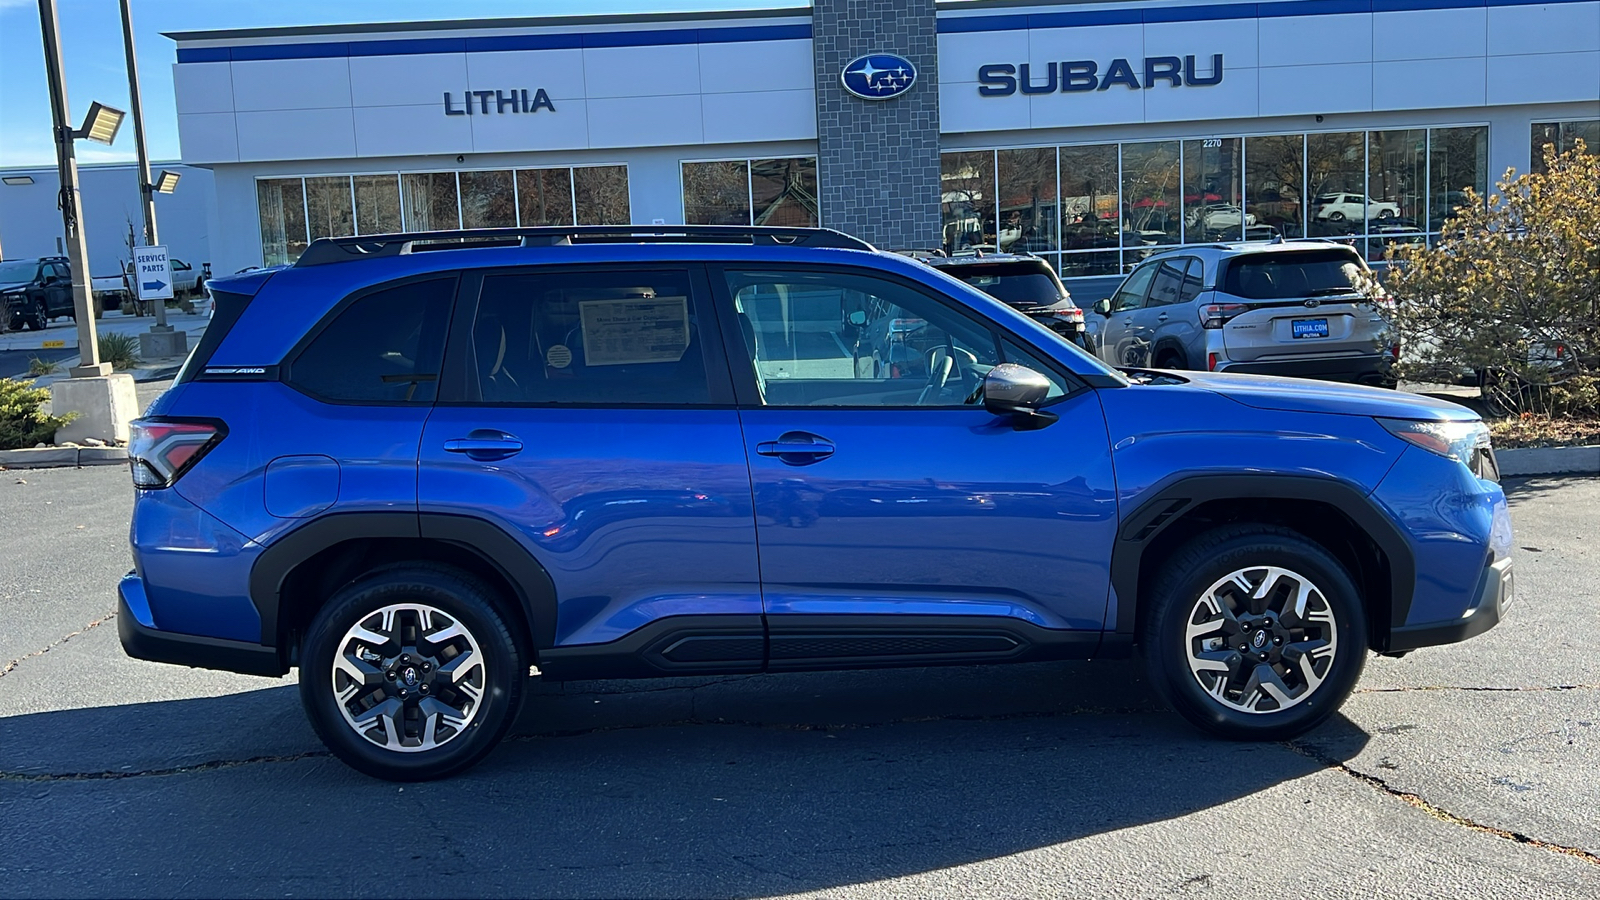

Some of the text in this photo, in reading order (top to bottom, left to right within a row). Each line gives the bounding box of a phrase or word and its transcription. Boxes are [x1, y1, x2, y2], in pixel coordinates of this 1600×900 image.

[978, 54, 1223, 97] SUBARU
[444, 88, 556, 115] LITHIA
[1203, 139, 1222, 148] 2270
[138, 254, 166, 263] SERVICE
[142, 264, 164, 272] PARTS
[1293, 324, 1328, 332] LITHIA.COM
